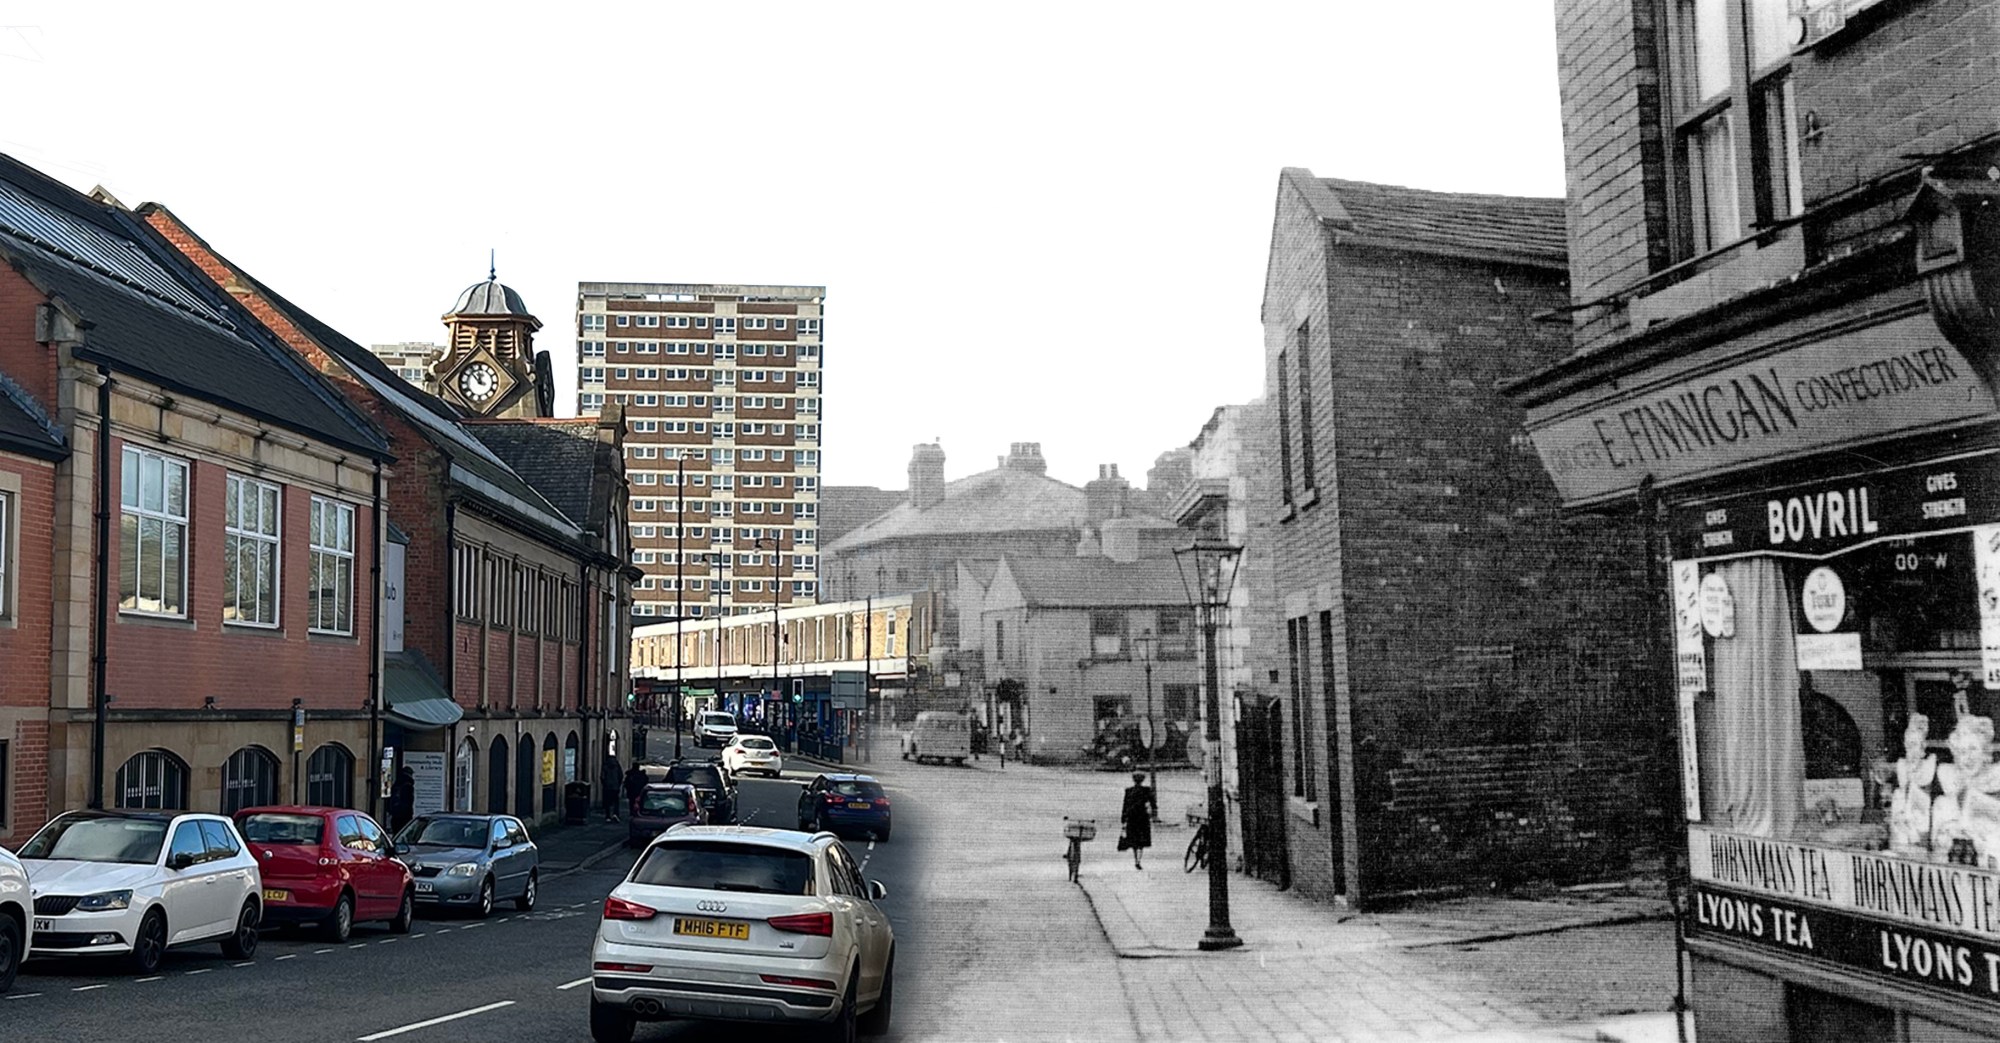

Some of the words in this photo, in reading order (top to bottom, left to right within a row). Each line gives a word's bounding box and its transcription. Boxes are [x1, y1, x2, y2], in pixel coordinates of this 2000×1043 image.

[1795, 346, 1958, 412] CONFECTIONER
[1767, 486, 1878, 544] BOVRIL
[1710, 834, 1796, 893] HORNIMANS
[1799, 847, 1832, 900] TEA
[1852, 855, 1963, 926] HORNIMANS
[1968, 873, 2000, 933] TE
[683, 919, 713, 935] MH16
[717, 923, 745, 938] FTF
[1697, 891, 1763, 937] LYONS
[1770, 907, 1813, 949] TEA
[1880, 930, 1973, 986] LYONS
